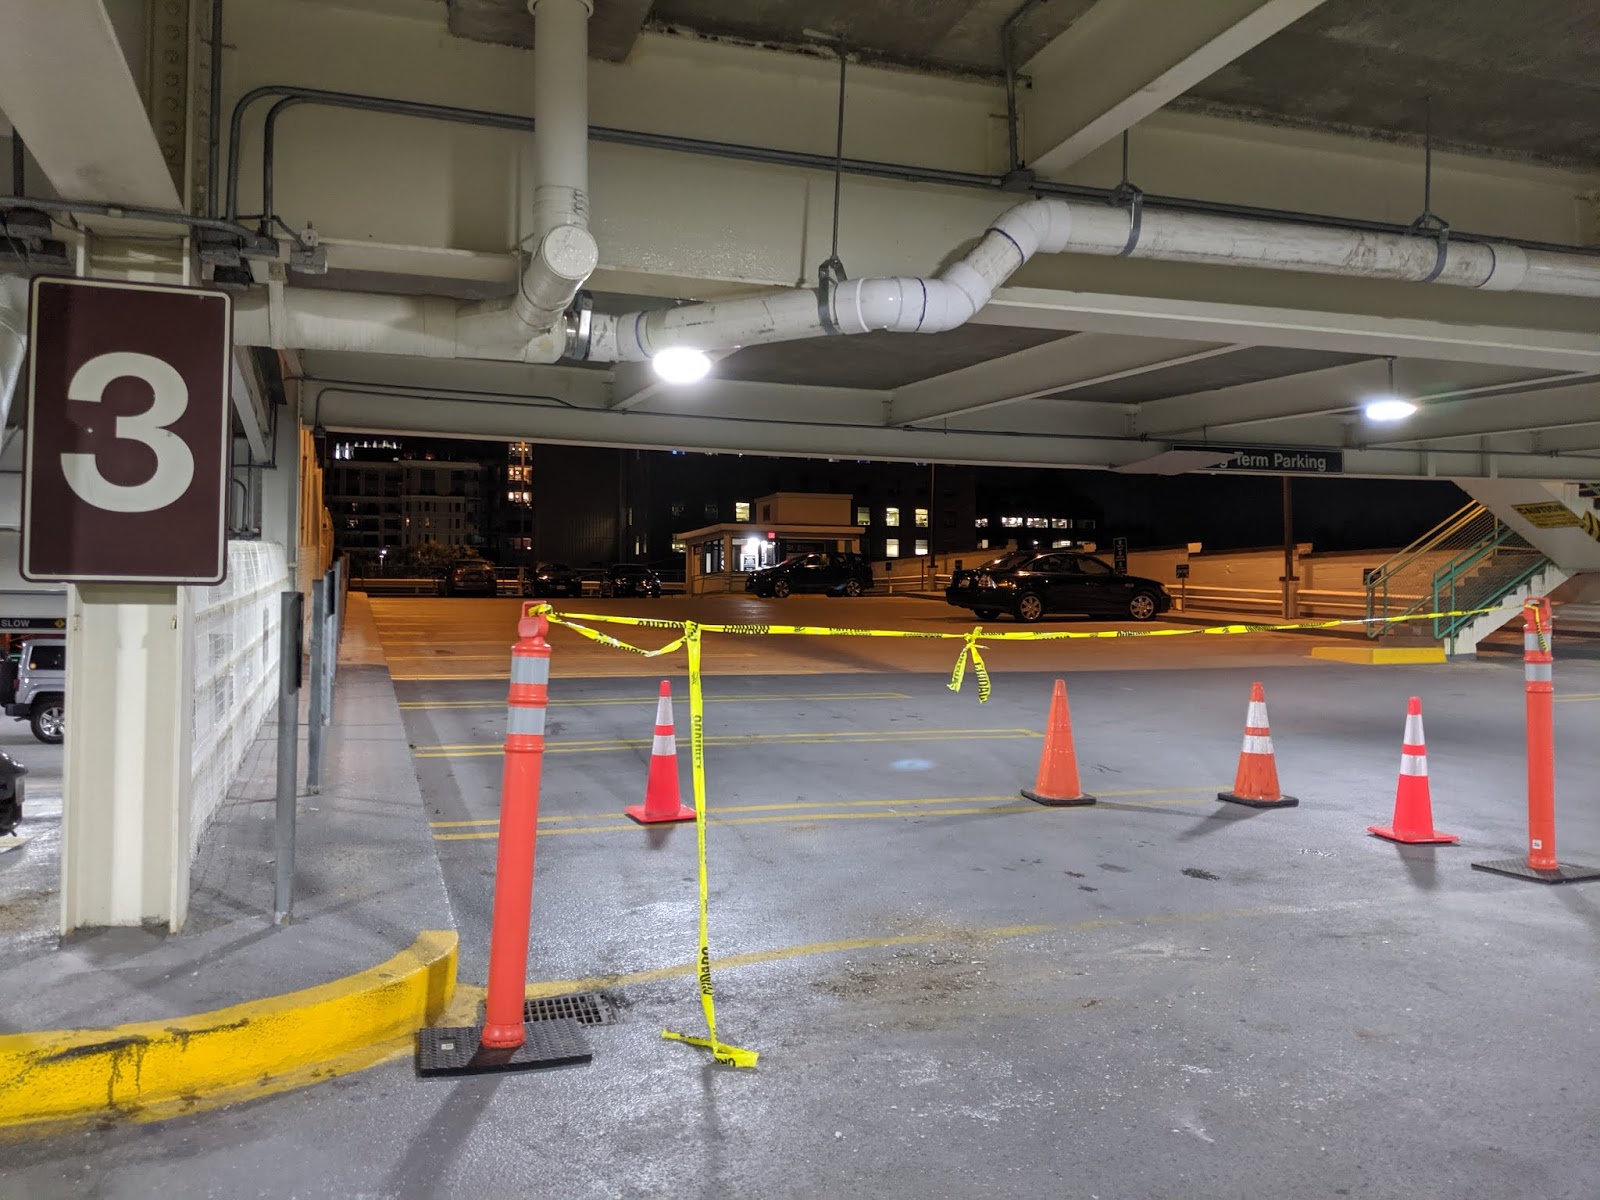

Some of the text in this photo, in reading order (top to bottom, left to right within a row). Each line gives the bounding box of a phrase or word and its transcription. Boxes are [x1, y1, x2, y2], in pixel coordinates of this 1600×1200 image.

[60, 352, 194, 512] 3
[1234, 451, 1269, 467] Term
[1274, 452, 1327, 472] Parking
[1, 619, 30, 628] SLOW
